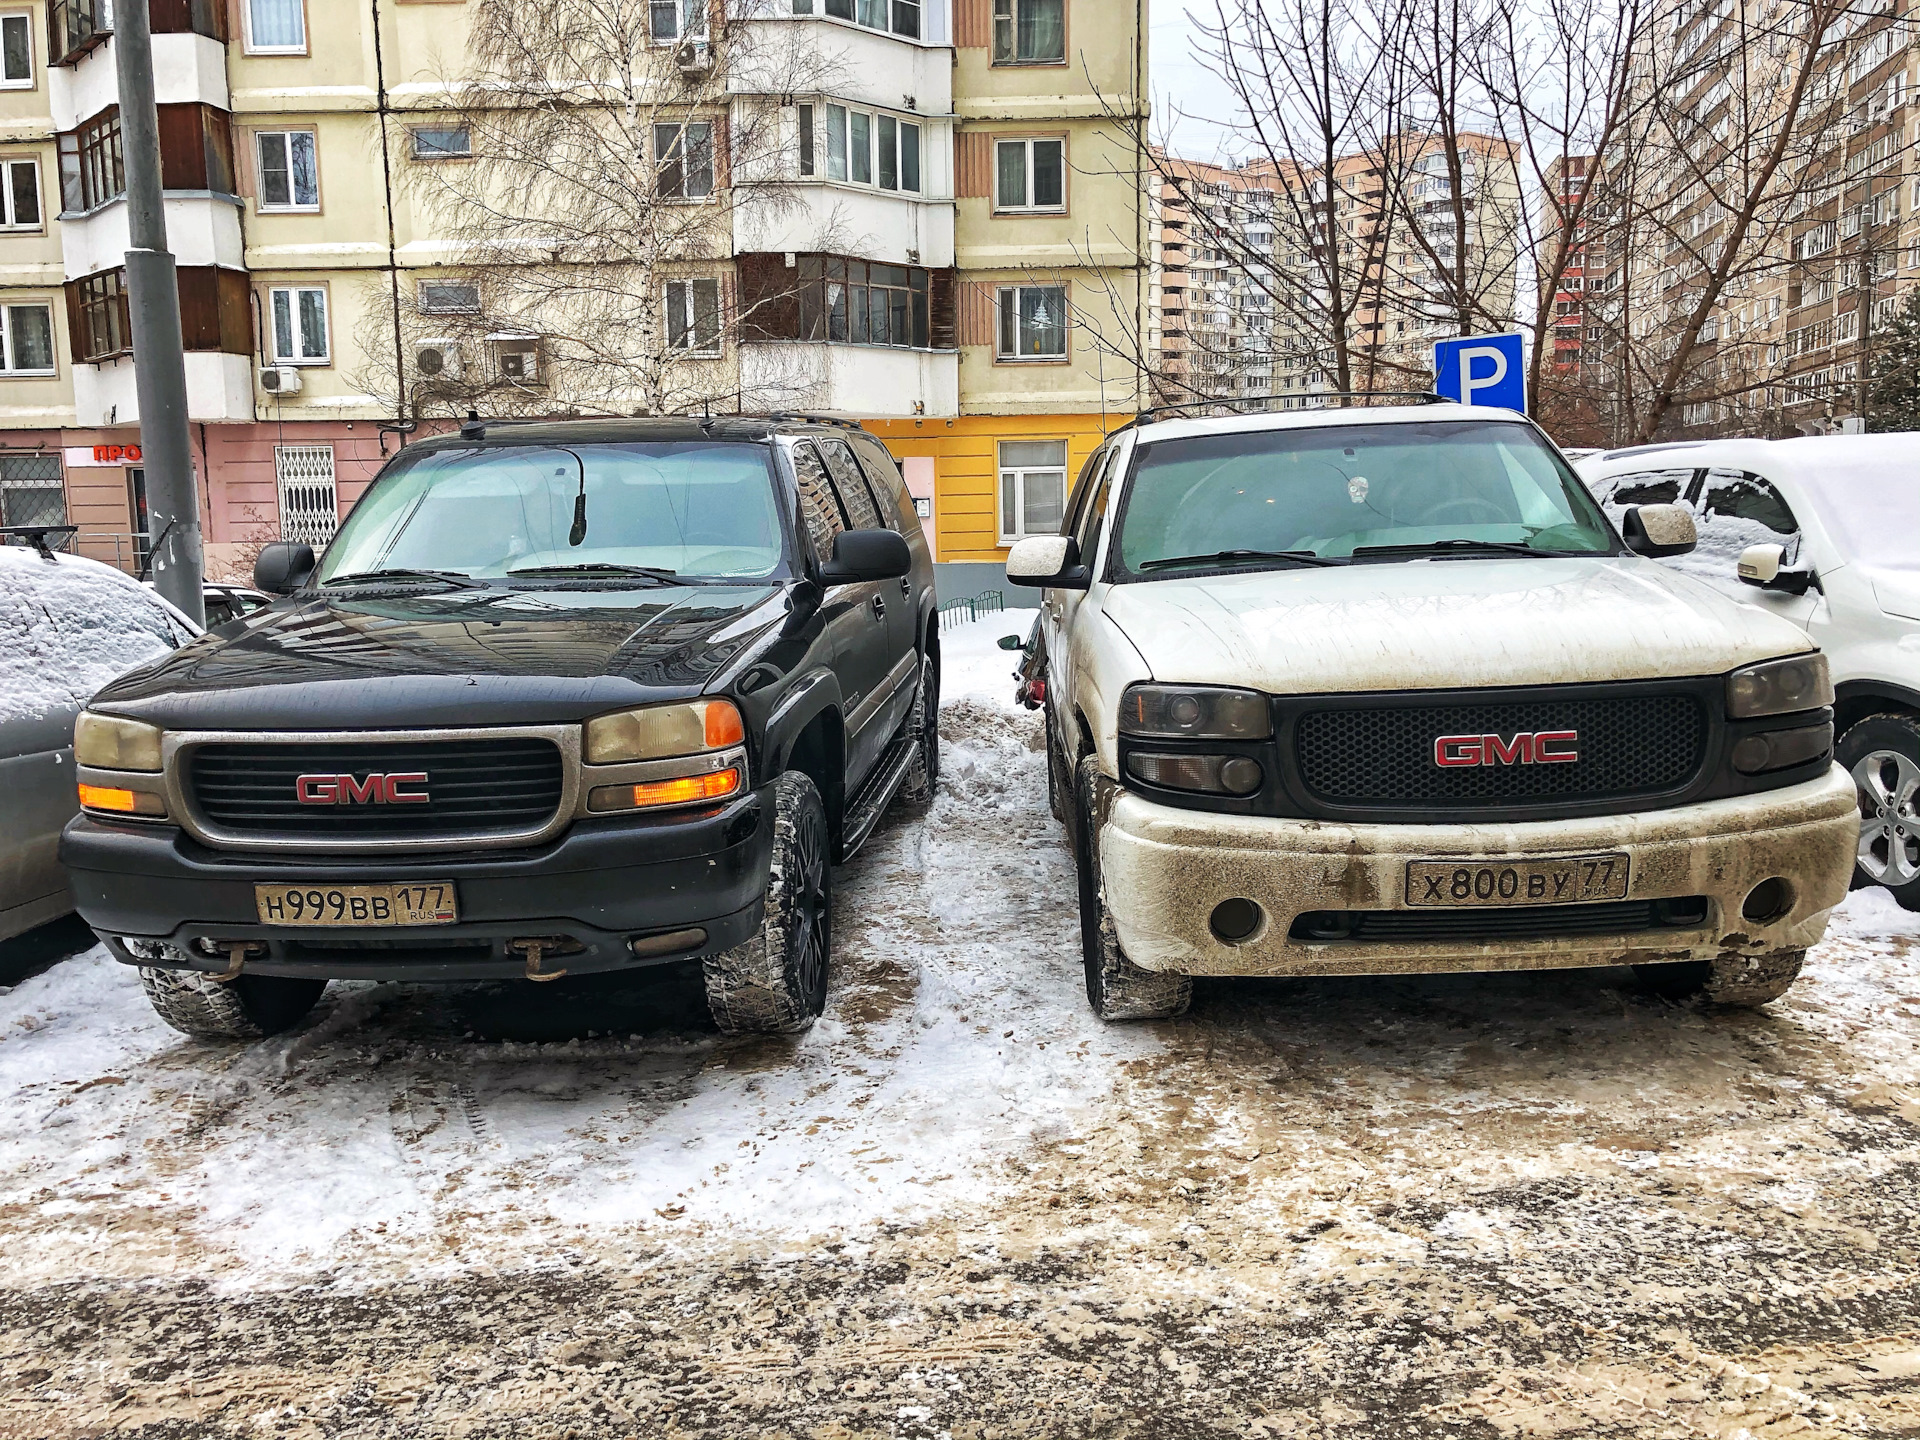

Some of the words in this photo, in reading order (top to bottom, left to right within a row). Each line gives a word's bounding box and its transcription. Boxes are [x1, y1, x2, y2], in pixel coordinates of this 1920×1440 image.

[1459, 346, 1508, 406] P
[1434, 730, 1578, 767] GMC
[296, 772, 430, 805] GMC
[1583, 861, 1615, 886] 77
[397, 887, 444, 910] 177
[410, 911, 435, 920] RUS
